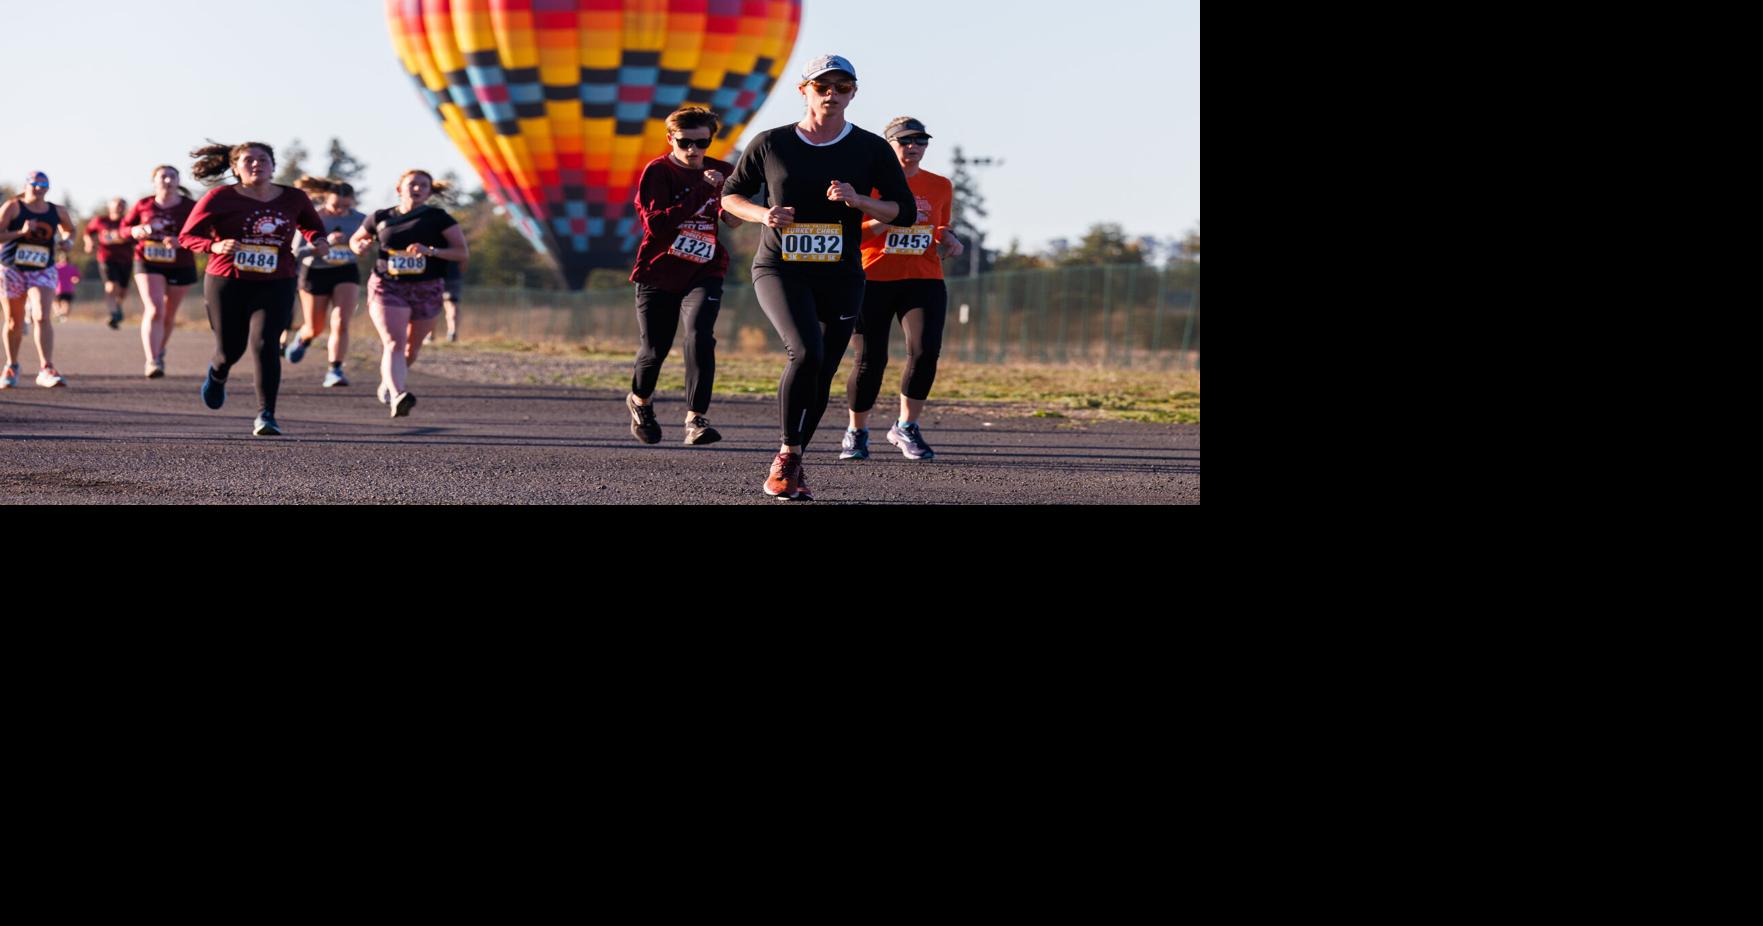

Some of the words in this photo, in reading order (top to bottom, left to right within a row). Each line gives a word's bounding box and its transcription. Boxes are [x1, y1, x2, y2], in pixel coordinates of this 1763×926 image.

[674, 237, 713, 259] 1321
[785, 234, 840, 254] 0032
[888, 233, 930, 249] 0453
[237, 252, 275, 267] 0484
[392, 257, 424, 269] 1208
